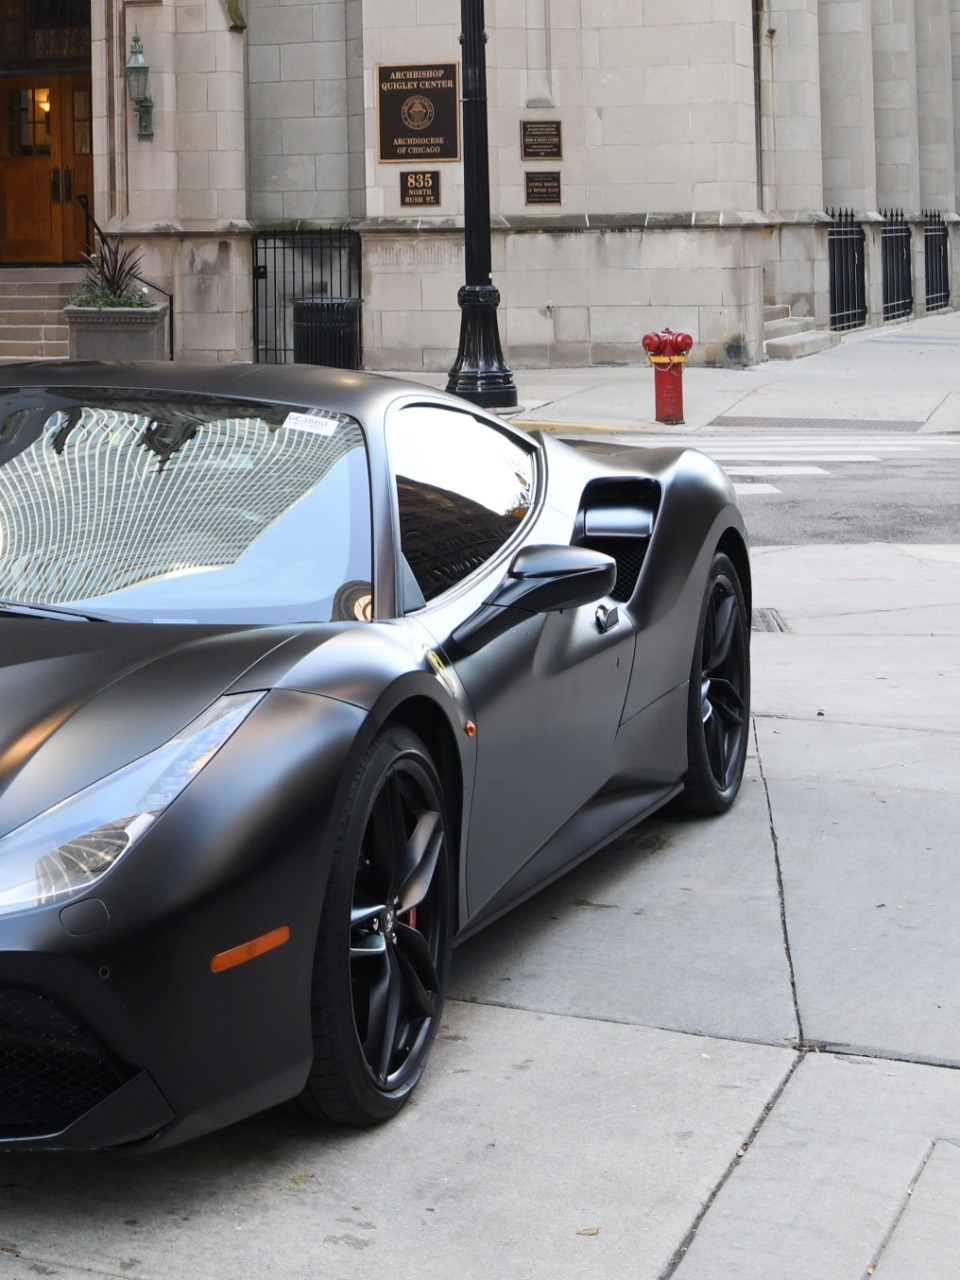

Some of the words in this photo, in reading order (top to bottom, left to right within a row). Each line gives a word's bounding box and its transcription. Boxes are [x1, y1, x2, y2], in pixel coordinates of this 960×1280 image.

[390, 69, 445, 80] ARCHBISHOP
[381, 81, 418, 91] QUIGLEY
[419, 80, 454, 89] CENTER
[393, 137, 444, 146] ARCHDIOCESE
[407, 146, 441, 154] CHICAGO
[407, 173, 433, 188] 835
